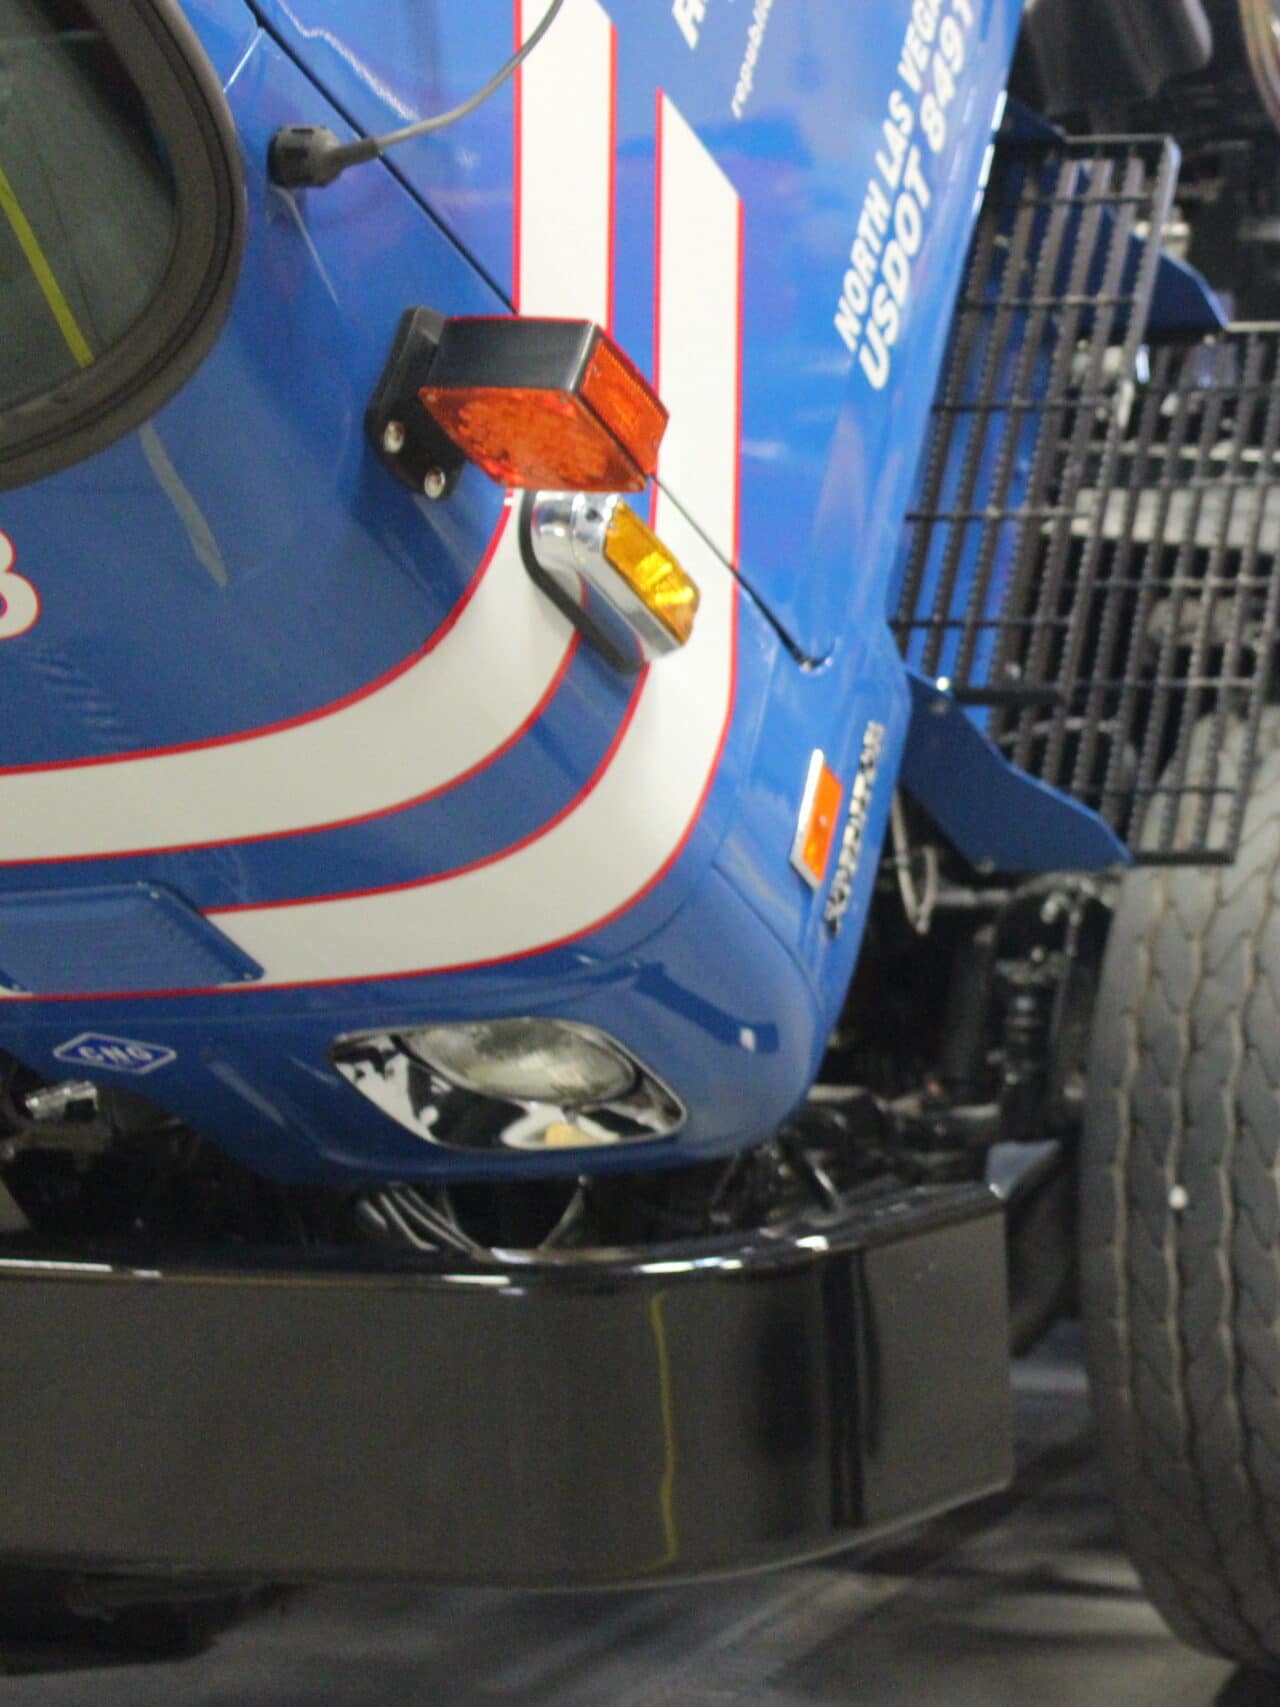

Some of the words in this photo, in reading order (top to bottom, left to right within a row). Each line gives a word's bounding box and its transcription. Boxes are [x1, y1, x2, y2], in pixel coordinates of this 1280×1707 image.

[834, 179, 892, 353] NORTH
[875, 90, 913, 191] LAS
[898, 0, 939, 92] VEG
[859, 145, 931, 390] USDOT
